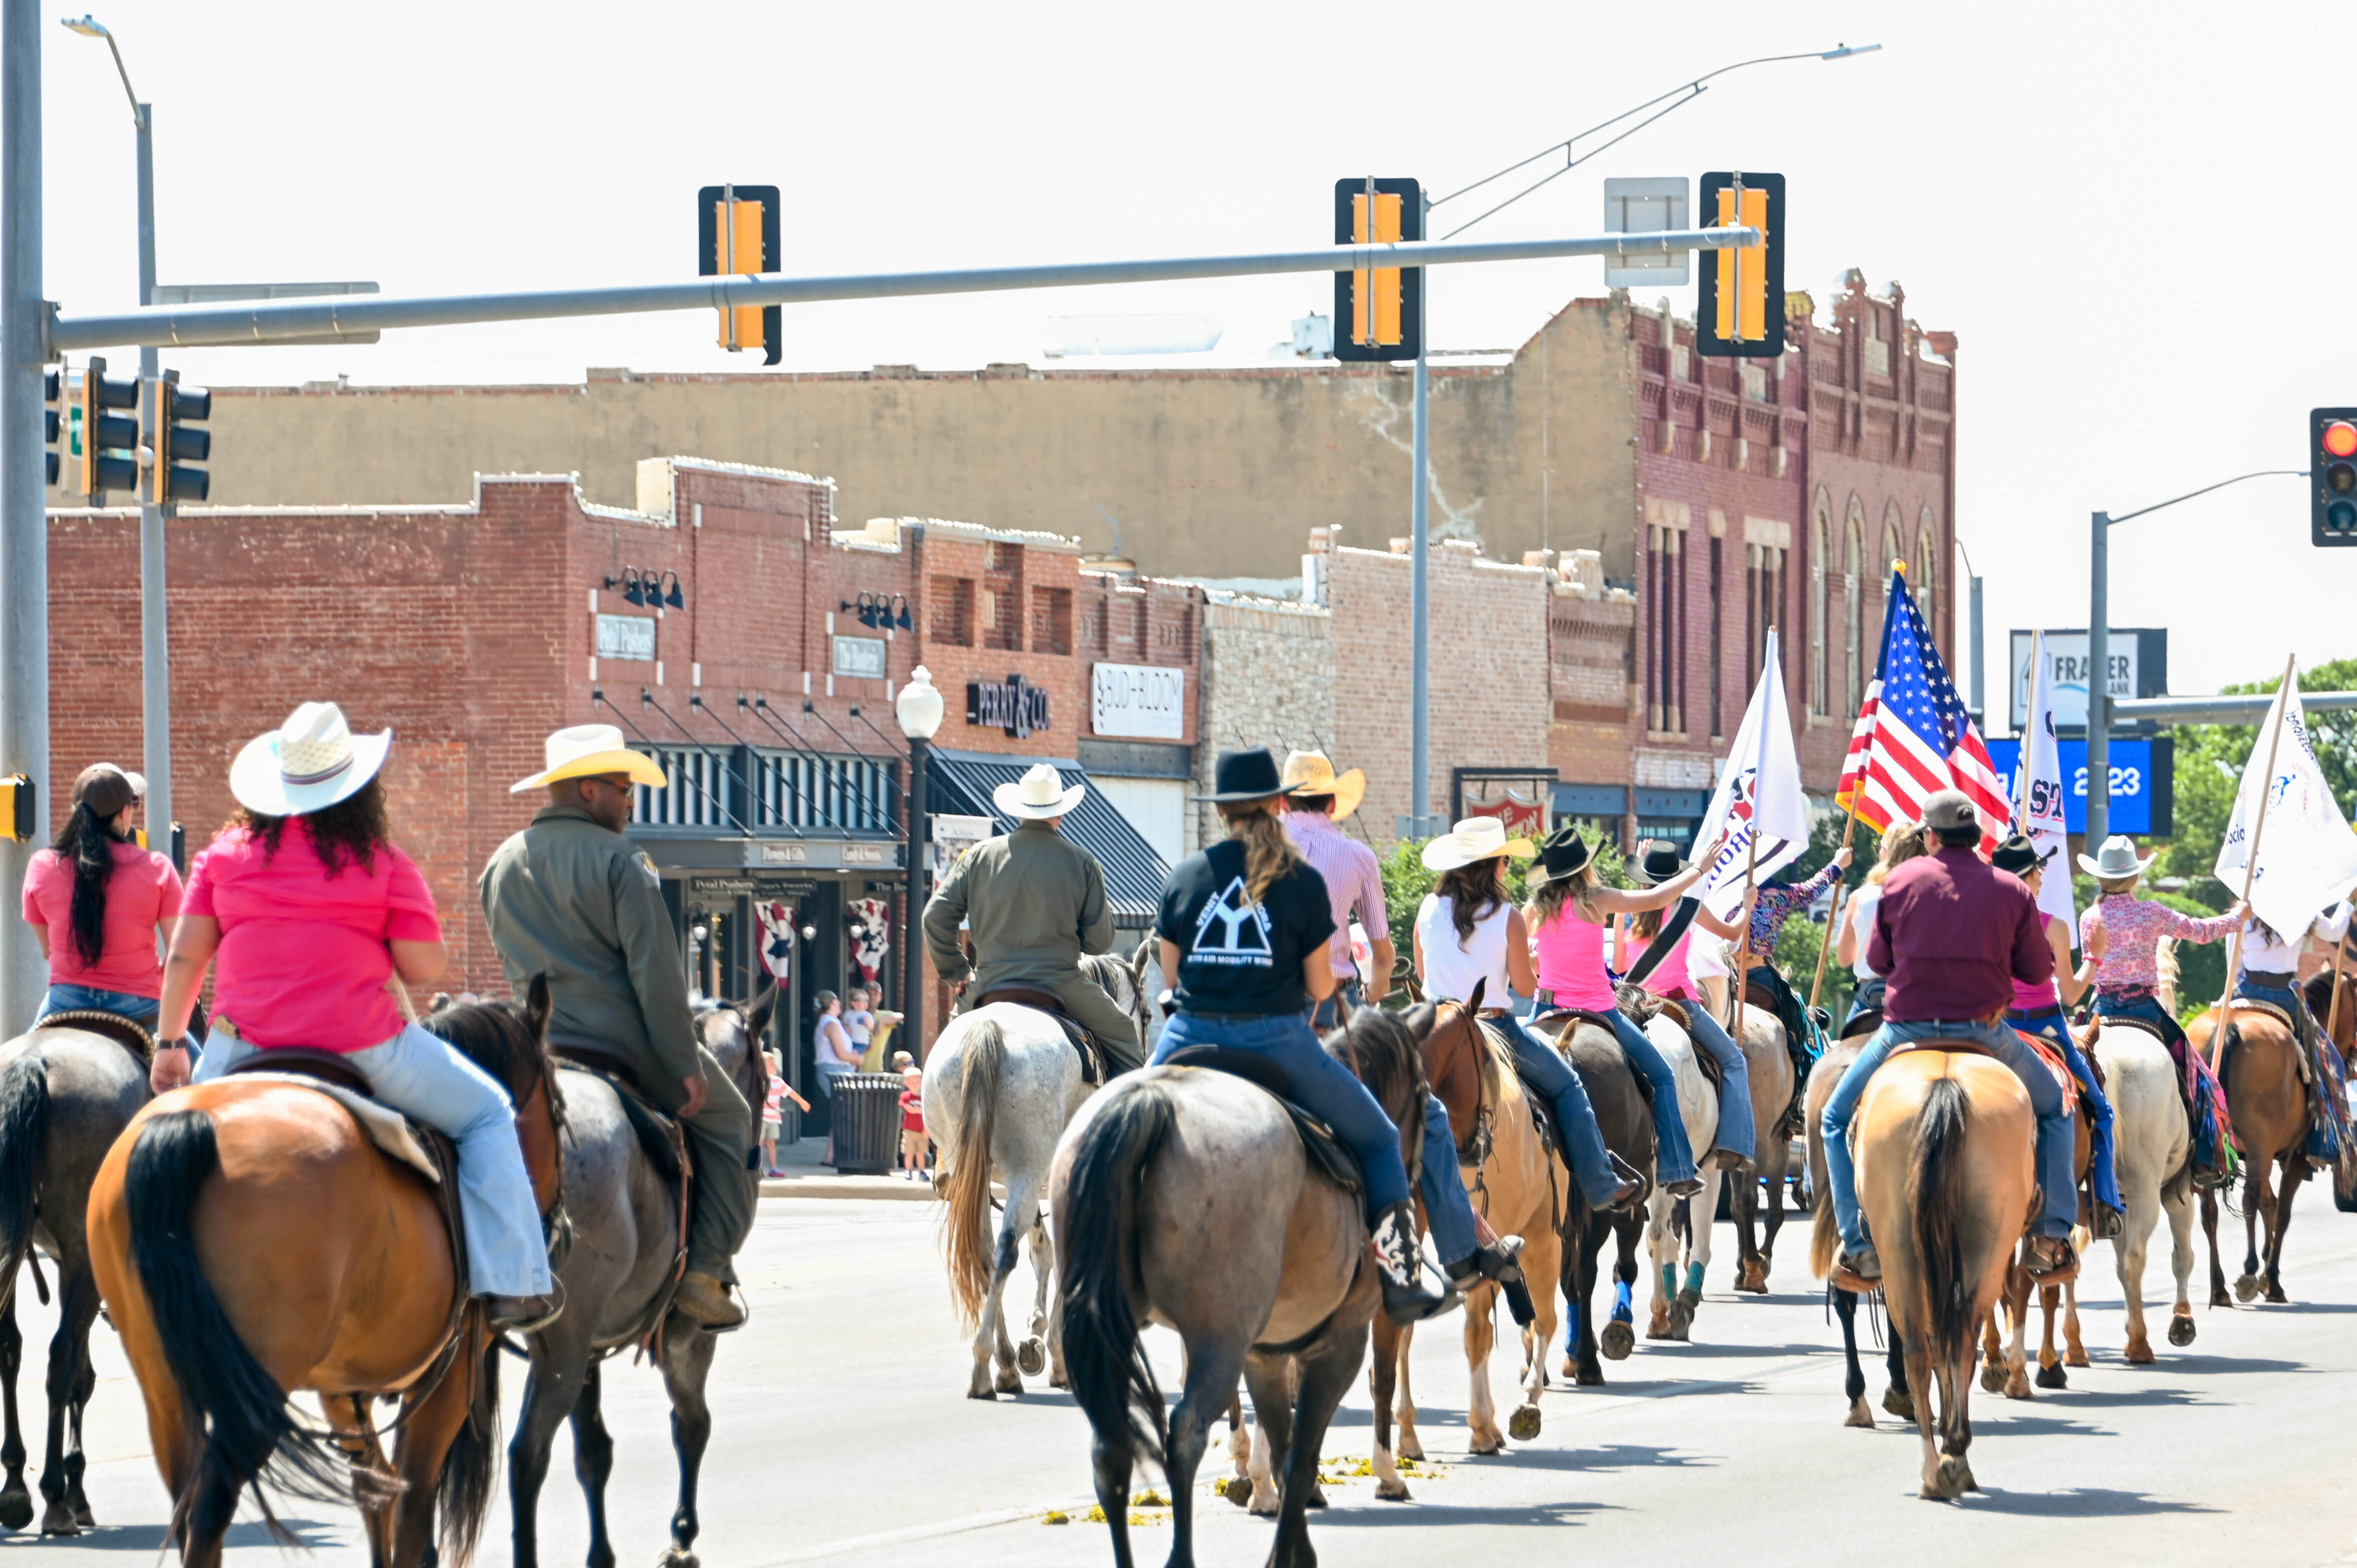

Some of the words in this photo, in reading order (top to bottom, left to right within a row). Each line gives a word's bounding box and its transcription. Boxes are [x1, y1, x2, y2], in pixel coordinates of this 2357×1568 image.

[2055, 655, 2129, 681] FRAER
[2106, 680, 2130, 695] ANK
[979, 681, 1016, 728] PERRY
[1016, 673, 1032, 739] &
[2074, 766, 2140, 796] 223
[695, 880, 718, 889] Petal
[719, 880, 754, 890] Pushers
[1196, 891, 1220, 926] VENIT
[1255, 900, 1272, 933] ORA
[1203, 954, 1217, 963] AIR
[1217, 955, 1252, 964] MOBILITY
